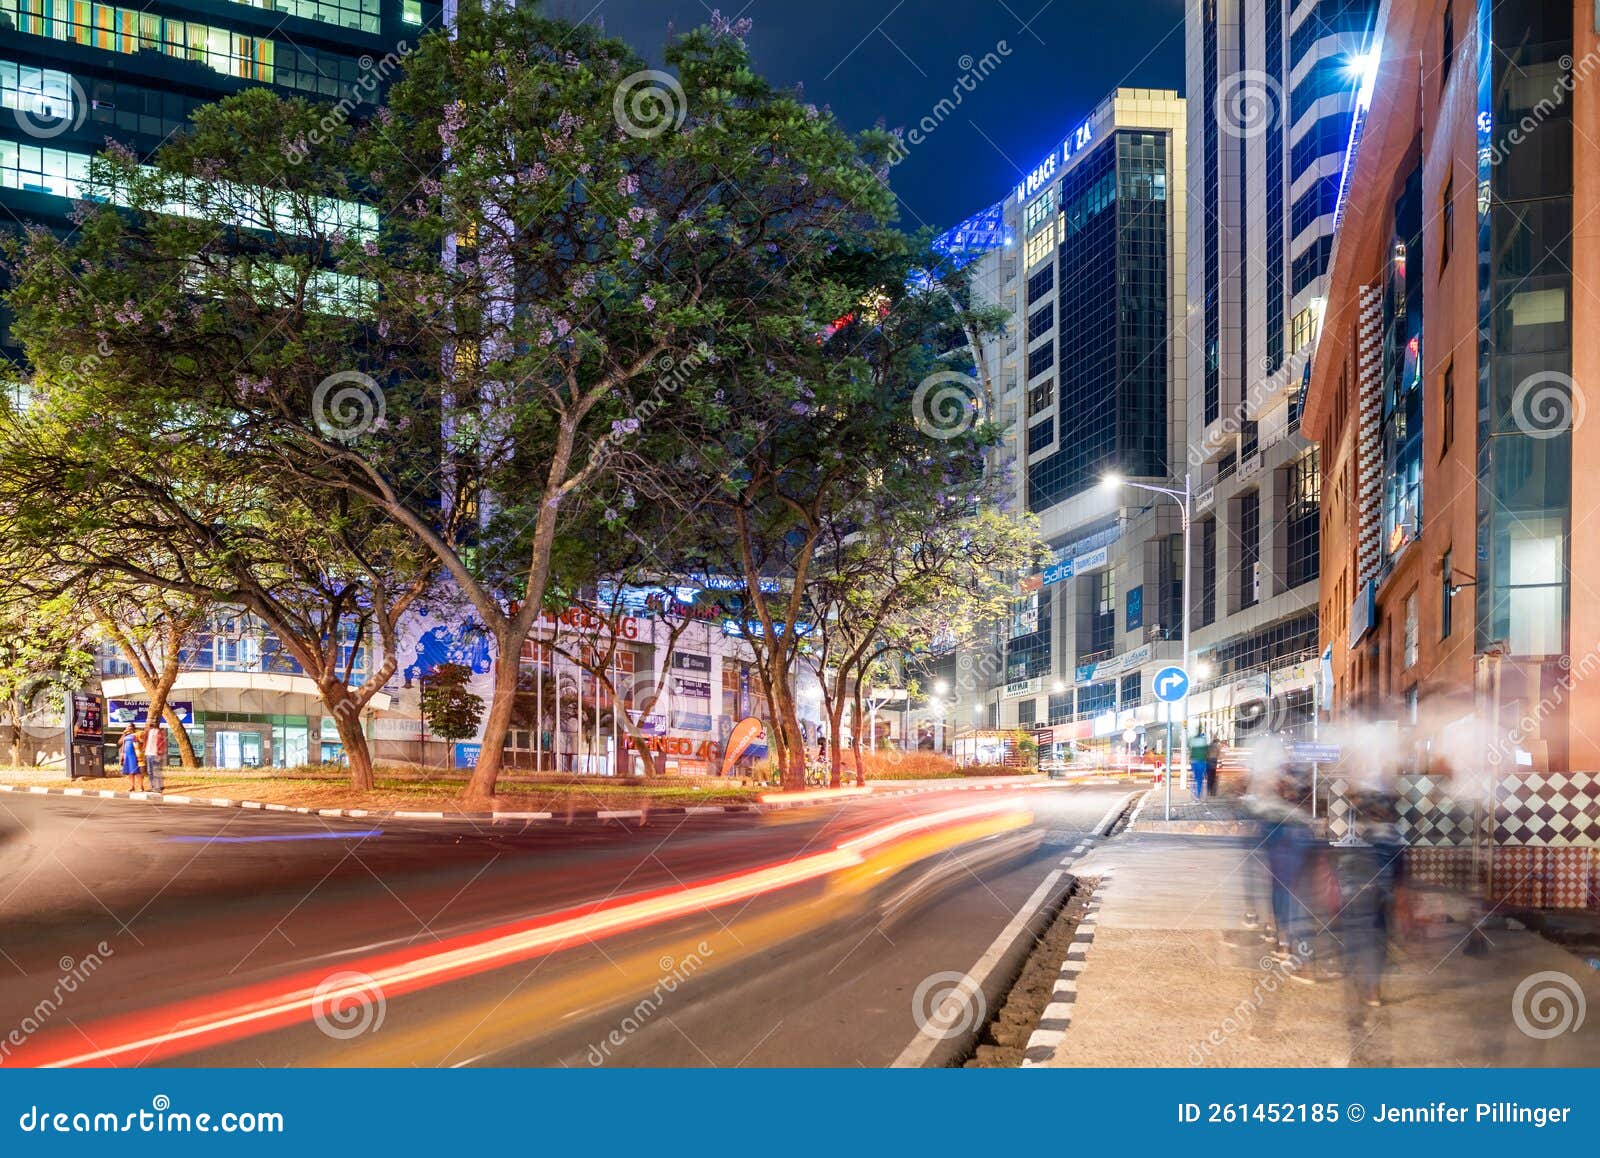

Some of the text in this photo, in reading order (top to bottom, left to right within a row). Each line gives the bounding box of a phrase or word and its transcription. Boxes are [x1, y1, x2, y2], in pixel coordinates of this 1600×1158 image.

[1027, 153, 1055, 196] PEACE
[1043, 561, 1073, 585] Saltel
[695, 741, 720, 763] 4G
